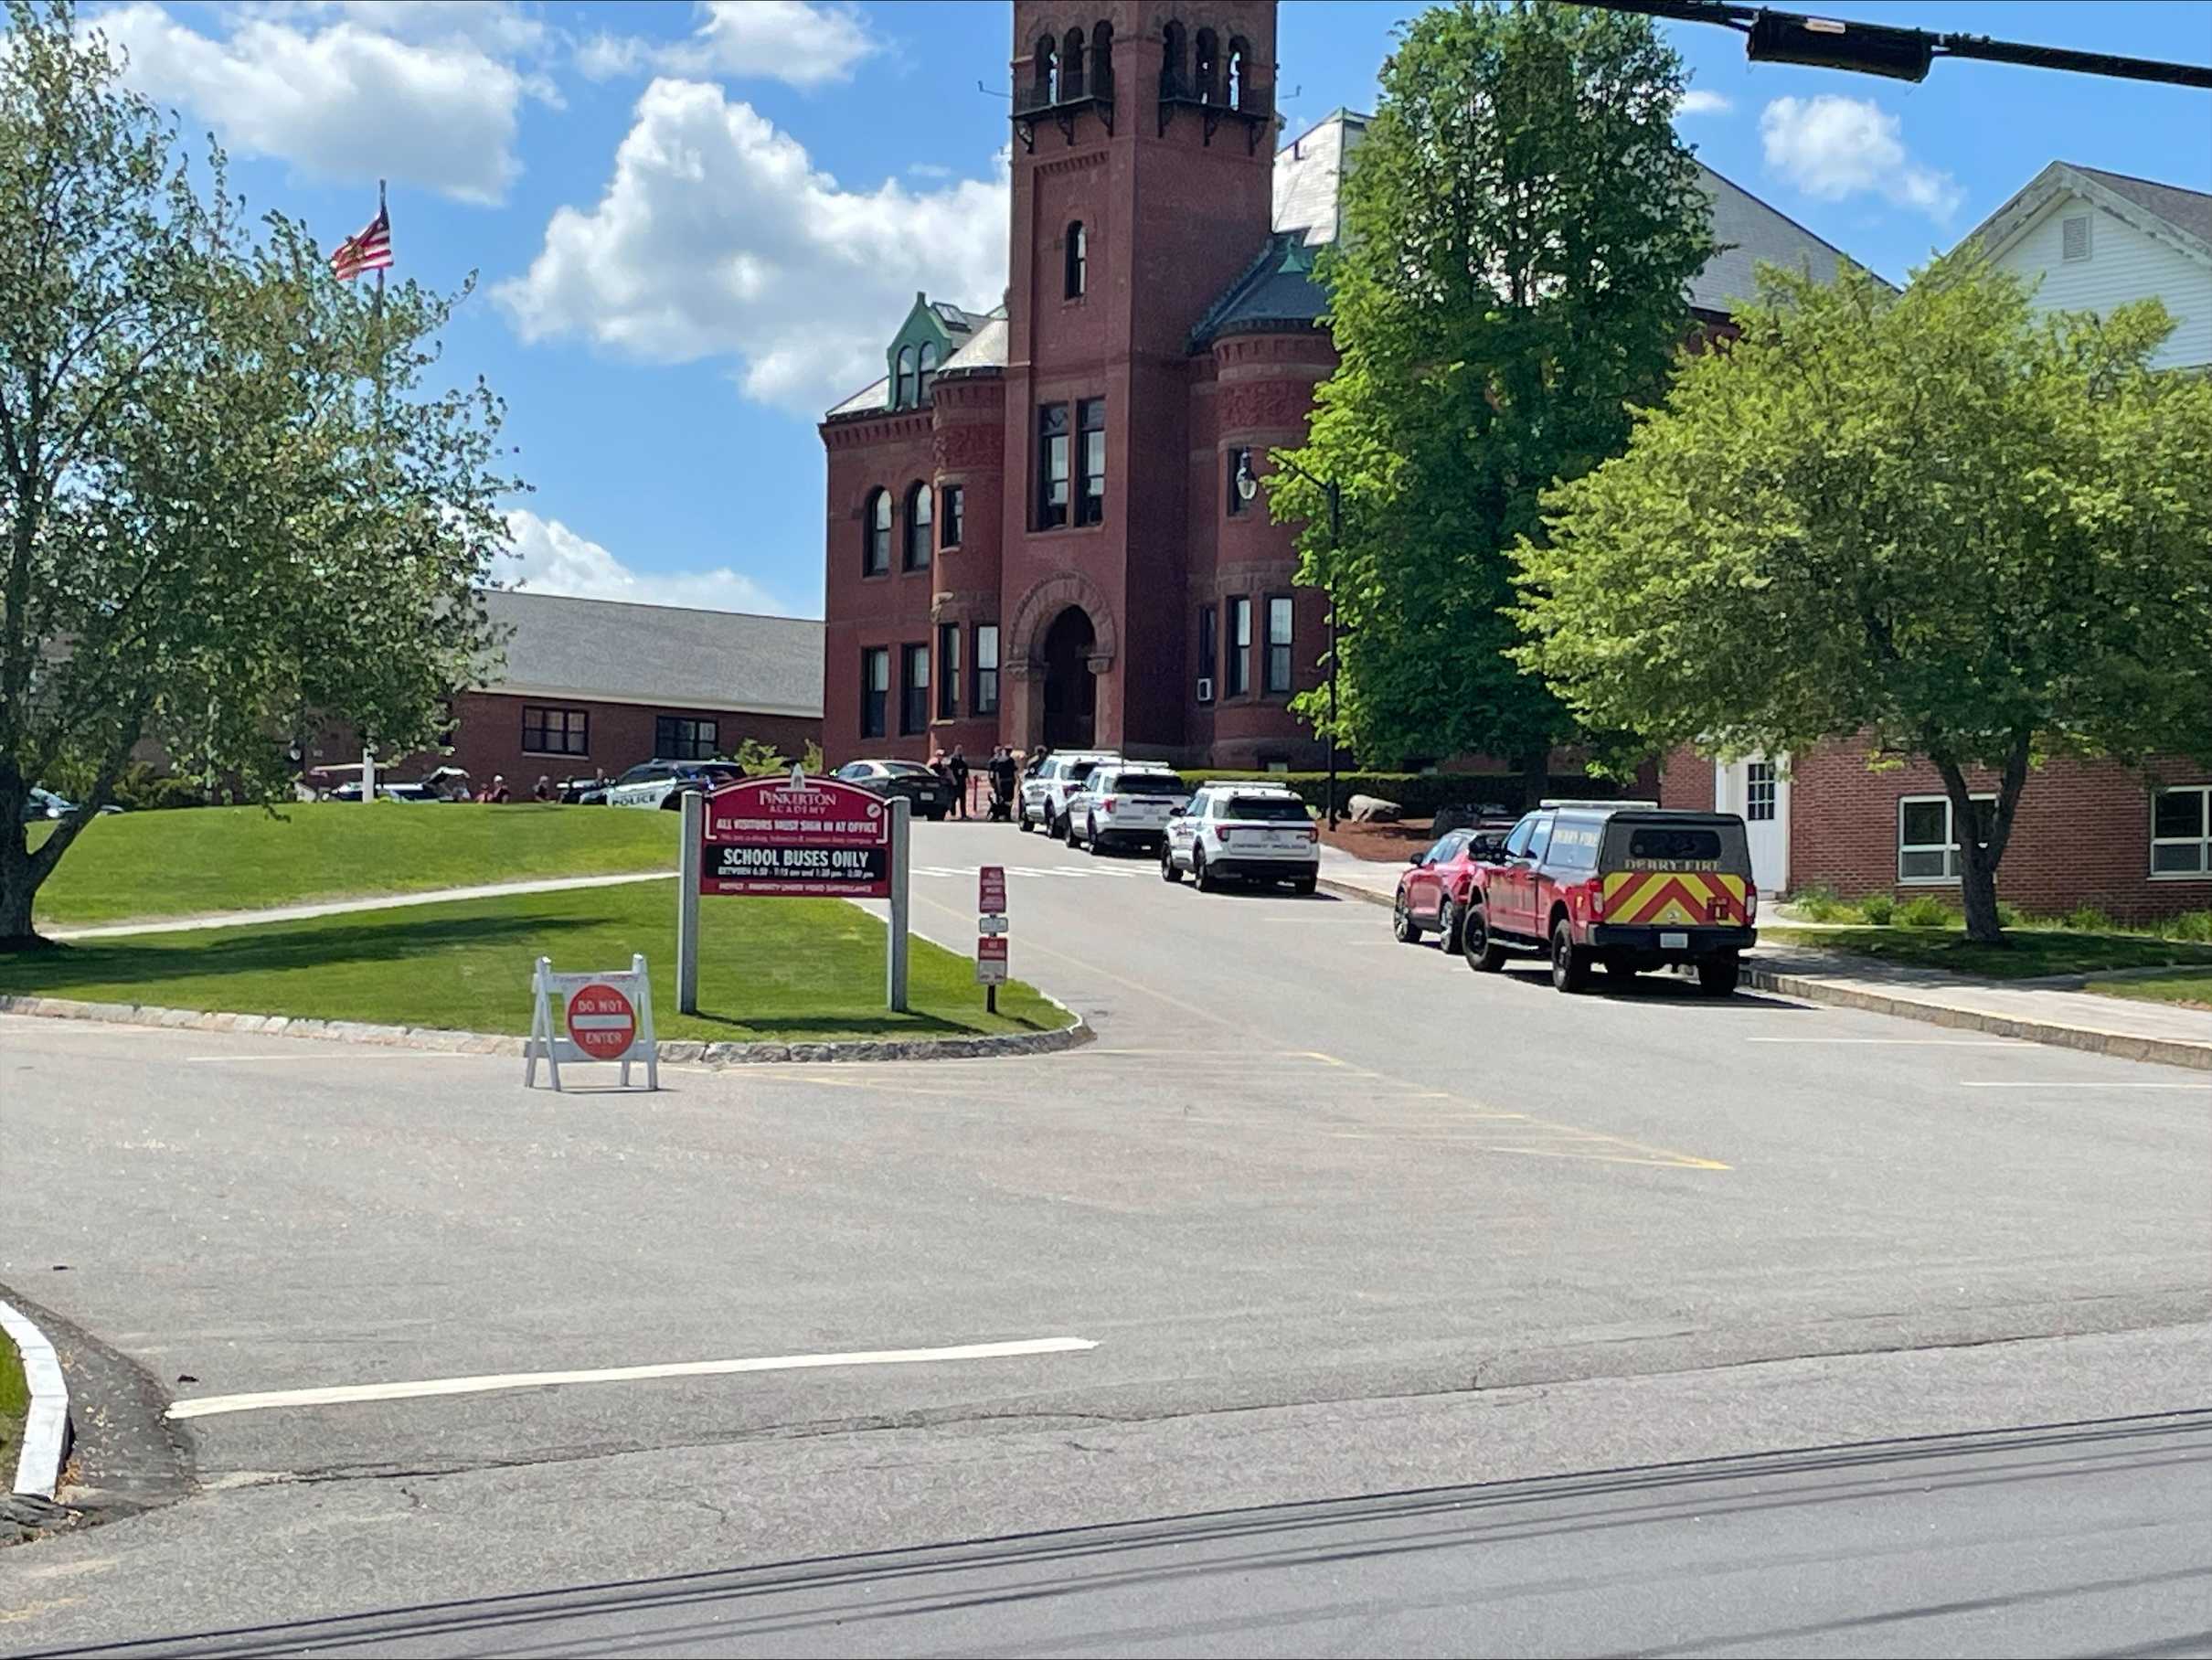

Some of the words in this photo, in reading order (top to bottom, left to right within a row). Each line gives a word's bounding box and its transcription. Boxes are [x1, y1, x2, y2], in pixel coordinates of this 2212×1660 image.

[612, 794, 656, 806] POLICE
[759, 790, 836, 805] PINKERTON
[770, 805, 826, 814] ACADEMY
[717, 818, 732, 829] ALL
[847, 822, 877, 834] OFFICE
[723, 848, 780, 866] SCHOOL
[783, 849, 829, 867] BUSES
[832, 851, 869, 867] ONLY
[1624, 859, 1677, 871] DERRY
[1685, 860, 1720, 871] FIRE
[578, 1000, 595, 1012] DO
[599, 1000, 622, 1012] NOT
[585, 1032, 622, 1044] ENTER
